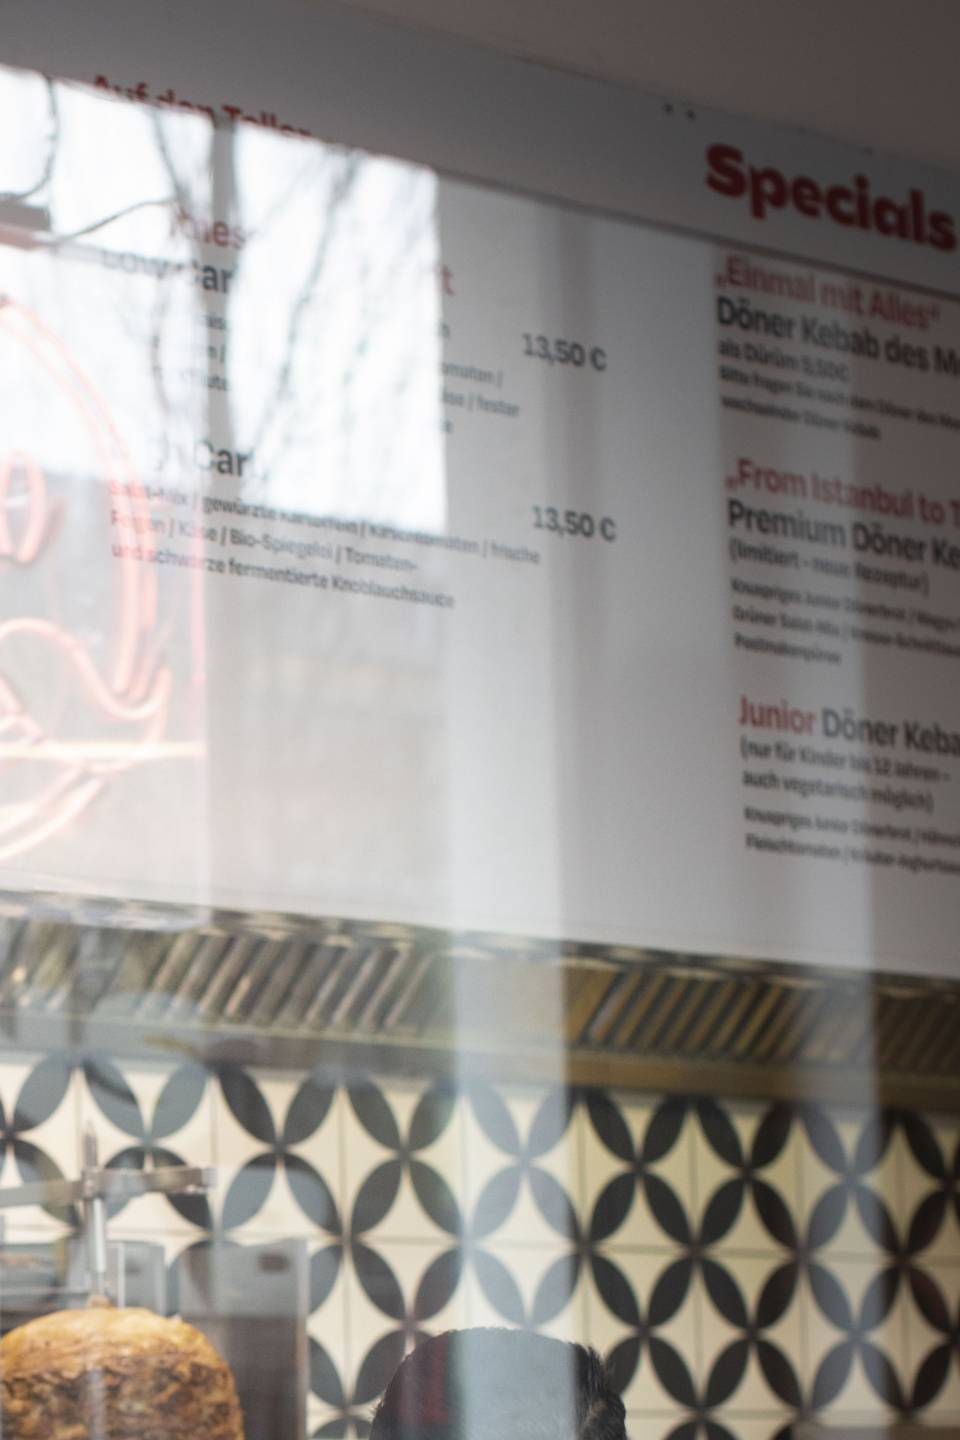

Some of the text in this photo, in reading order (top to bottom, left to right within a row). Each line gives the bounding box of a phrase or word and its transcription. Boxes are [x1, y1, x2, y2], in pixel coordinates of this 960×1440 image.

[705, 143, 958, 252] Specials
[523, 333, 585, 368] 13,50
[717, 296, 795, 340] Döner
[801, 314, 880, 360] Kebab
[884, 332, 930, 371] des
[531, 505, 596, 540] 13,50
[811, 471, 915, 520] Istanbul
[918, 494, 946, 525] to
[727, 498, 846, 548] Premium
[851, 521, 928, 563] Döner
[738, 694, 816, 736] Junior
[821, 705, 898, 748] Döner
